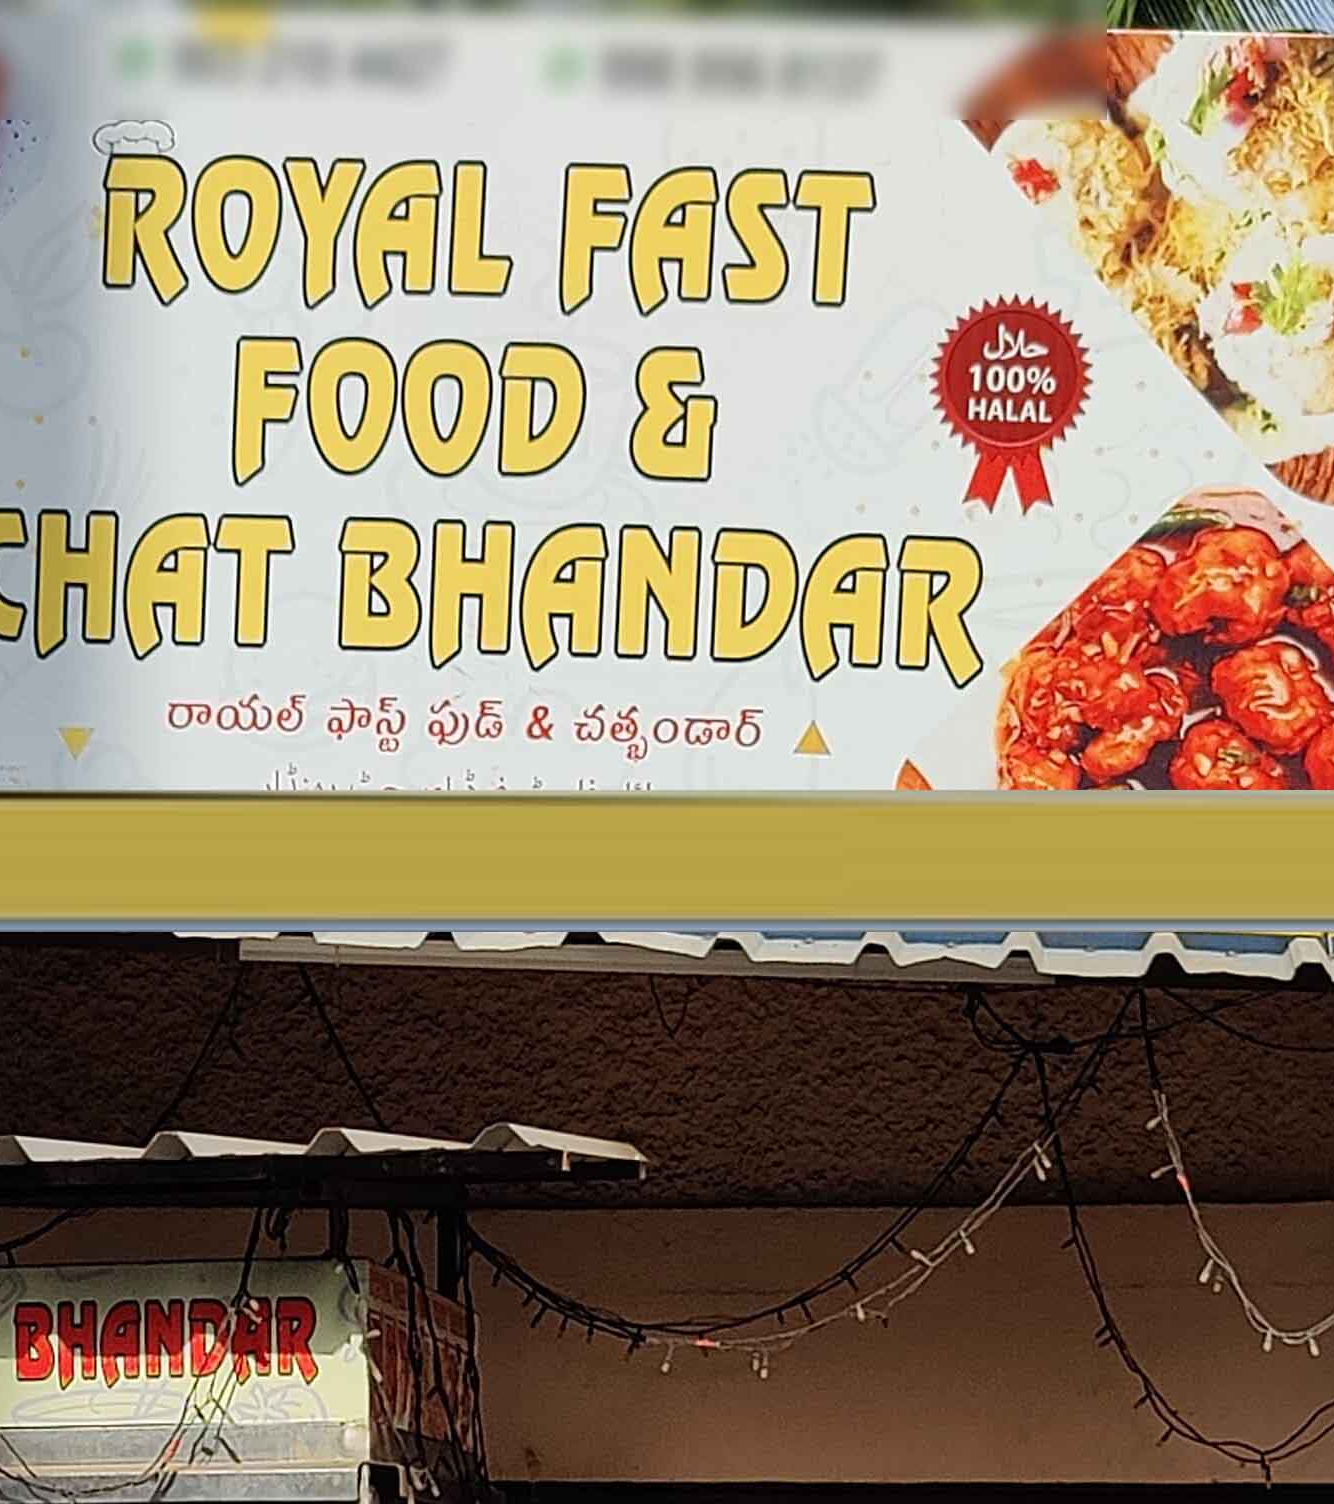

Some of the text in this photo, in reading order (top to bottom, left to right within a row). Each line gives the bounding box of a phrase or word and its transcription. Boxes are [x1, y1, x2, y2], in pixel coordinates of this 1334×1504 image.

[102, 155, 875, 315] ROYAL FAST
[232, 336, 718, 485] FOOD &
[969, 363, 1054, 395] 100%
[969, 397, 1052, 423] HALAL
[336, 517, 984, 688] BHANDAR
[167, 694, 307, 733] రాయల్
[527, 706, 553, 740] &
[13, 1294, 318, 1389] BHANDAR
